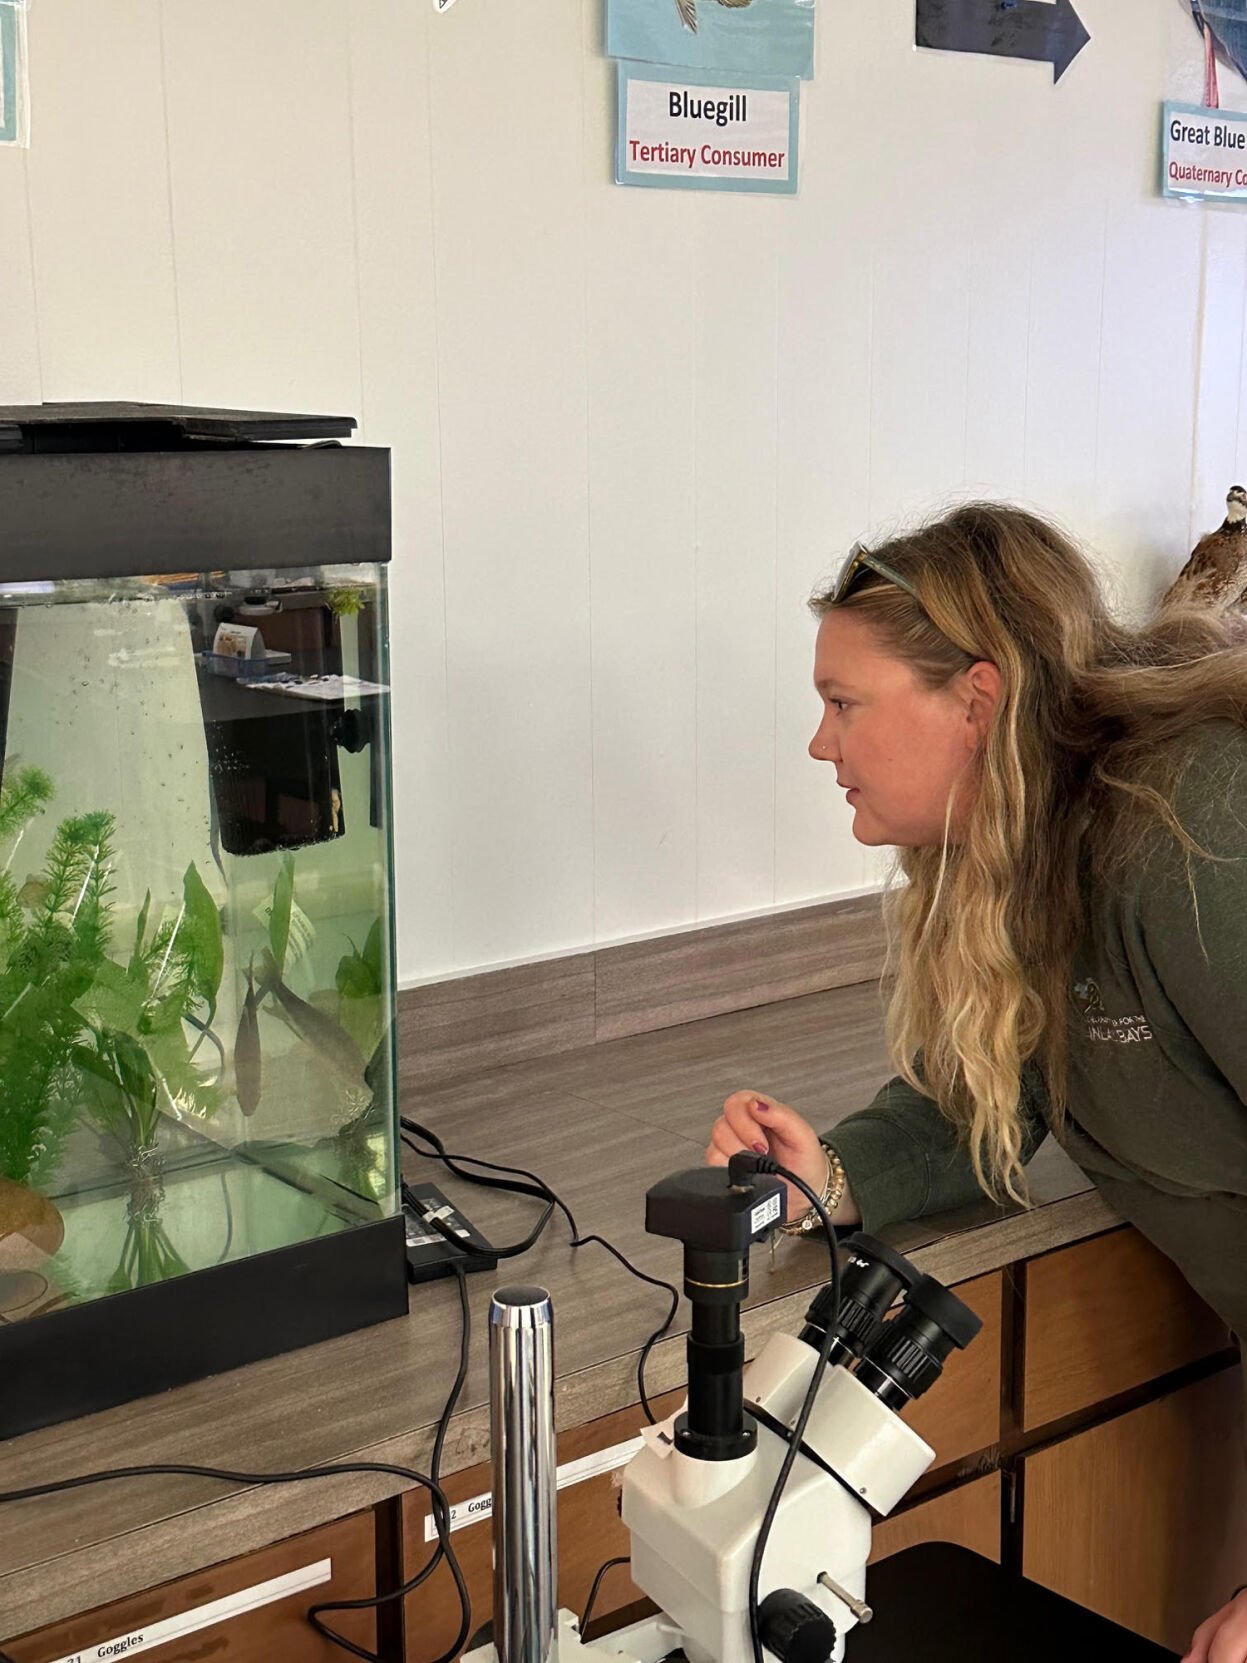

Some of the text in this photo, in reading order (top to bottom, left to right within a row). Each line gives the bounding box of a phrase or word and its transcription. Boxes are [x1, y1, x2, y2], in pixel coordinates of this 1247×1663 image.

[669, 91, 747, 127] Bluegill
[1170, 119, 1246, 150] Great Blue
[629, 140, 785, 169] Tertiary Consumer
[1169, 161, 1233, 188] Quaternary
[97, 1634, 144, 1658] Goggles
